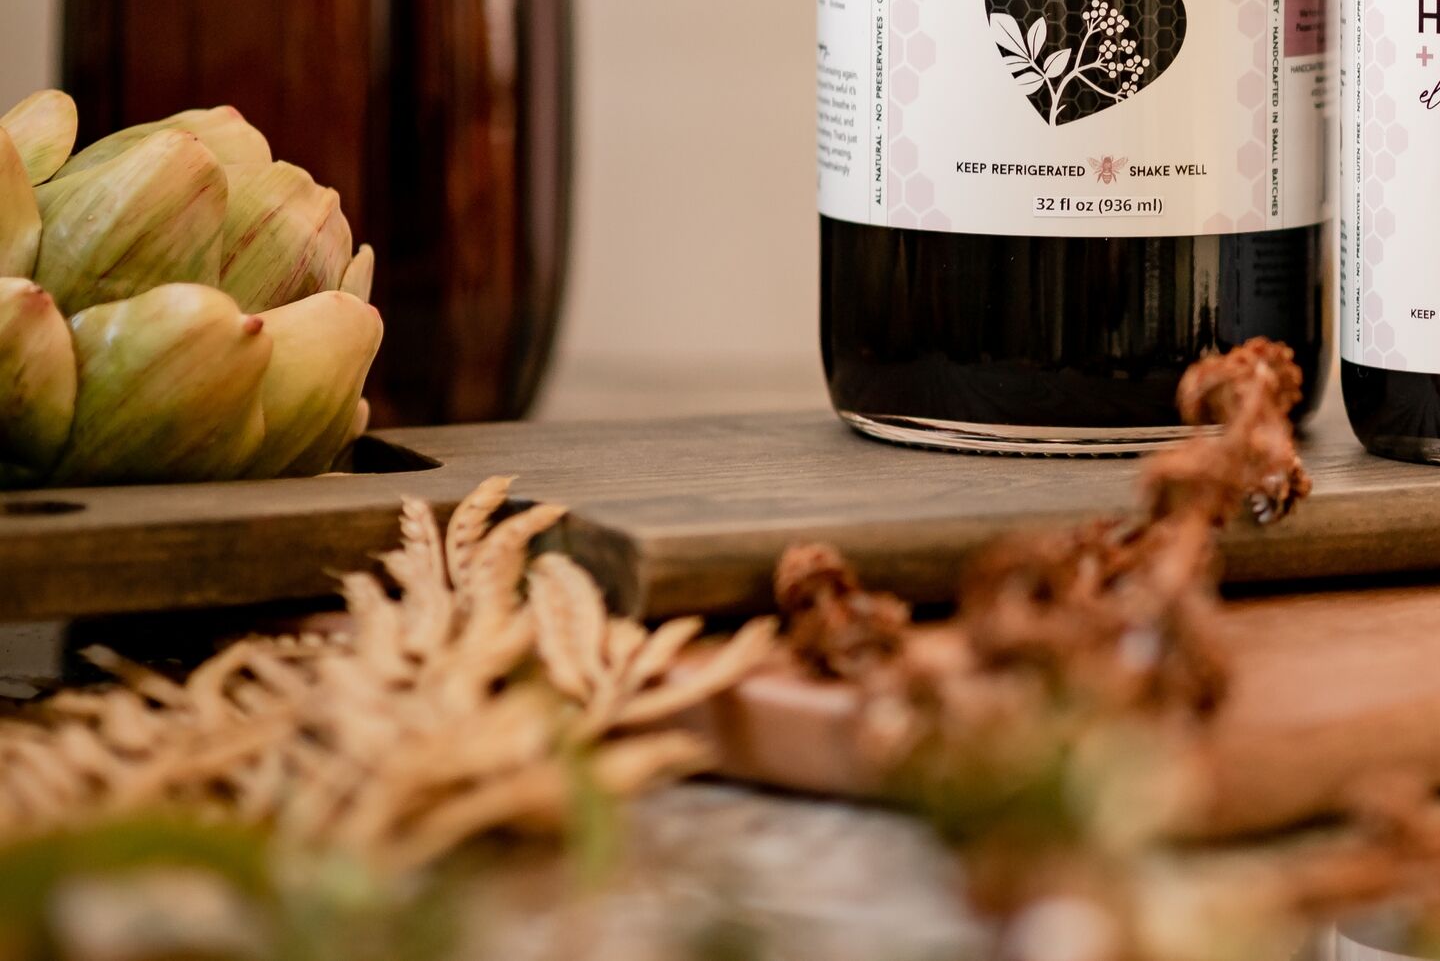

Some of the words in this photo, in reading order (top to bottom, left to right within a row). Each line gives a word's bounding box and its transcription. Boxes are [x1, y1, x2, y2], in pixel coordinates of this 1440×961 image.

[875, 16, 884, 99] PRESERVATIVES
[875, 104, 883, 122] NO
[1272, 112, 1279, 123] IN
[1271, 128, 1279, 163] SMALL
[875, 134, 883, 182] NATURAL
[956, 161, 987, 174] KEEP
[991, 163, 1086, 177] REFRIGERATED
[1129, 165, 1171, 177] SHAKE
[1174, 164, 1207, 176] WELL
[1271, 168, 1279, 216] BATCHES
[1036, 197, 1055, 211] 32
[1059, 197, 1070, 211] fl
[1075, 201, 1094, 212] oz
[1098, 198, 1132, 215] (936
[1137, 197, 1163, 214] ml)
[1410, 308, 1436, 320] KEEP
